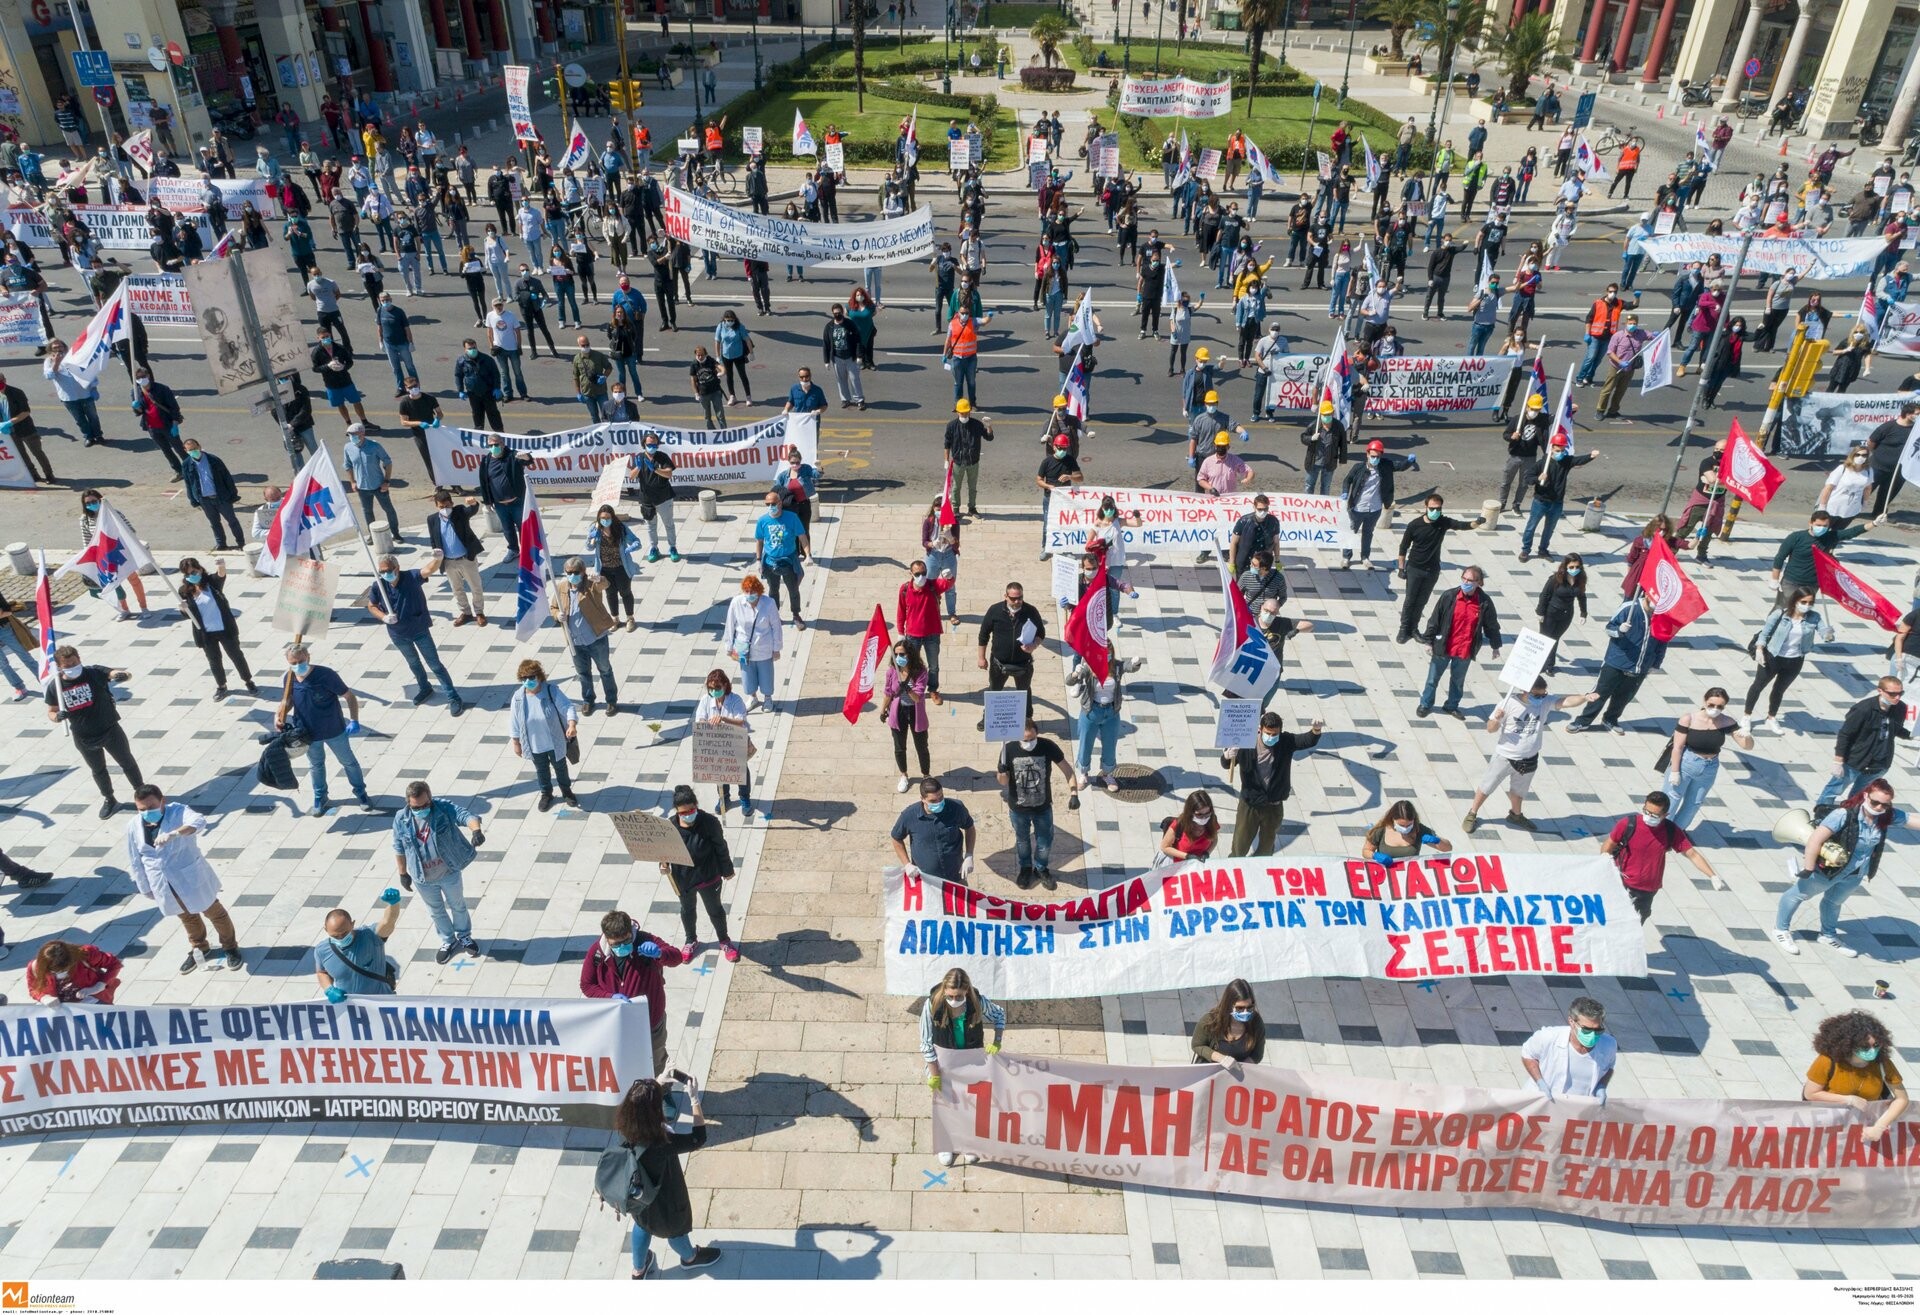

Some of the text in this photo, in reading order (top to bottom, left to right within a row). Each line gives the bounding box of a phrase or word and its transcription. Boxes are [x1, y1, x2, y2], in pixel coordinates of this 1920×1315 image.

[88, 213, 108, 226] ΣΤΟ
[665, 214, 691, 242] ΜΑΗ
[692, 207, 713, 225] ΔΕΝ
[851, 239, 860, 250] Ο
[119, 228, 134, 240] ΤΗΣ
[1381, 359, 1433, 372] ΔΩΡΕΑΝ
[1459, 358, 1486, 372] ΛΑΟ
[1407, 372, 1473, 384] ΔΙΚΑΙΩΜΑΤΑ
[1282, 381, 1501, 398] ΟΧΙ ΣΥΜΒΑΣΕΙΣ ΕΡΓΑΣΙΑΣ
[1365, 398, 1477, 411] ΑΖΟΜΕΝΩΝ ΦΑΡΜΑΚΟΥ
[567, 433, 604, 449] τους
[688, 431, 708, 445] τη
[756, 421, 785, 442] μας
[550, 476, 600, 485] ΒΙΟΜΗΧΑΝΙΚ
[697, 472, 747, 483] ΜΑΚΕΔΟΝΙΑΣ
[1059, 509, 1079, 526] ΝΑ
[1177, 509, 1217, 523] ΤΩΡΑ
[1143, 529, 1217, 544] ΜΕΤΑΛΛΟΥ
[904, 855, 1508, 922] Η ΠΡΩΤΟΜΑΓΙΑ ΕΙΝΑΙ ΤΩΝ ΕΡΓΑΤΩΝ
[899, 919, 1056, 957] ΑΠΑΝΤΗΣΗ
[1079, 915, 1150, 950] ΣΤΗΝ
[1316, 900, 1366, 927] ΤΩΝ
[1380, 894, 1606, 933] ΚΑΠΙΤΑΛΙΣΤΩΝ
[168, 1008, 213, 1046] ΔΕ
[221, 1004, 341, 1042] ΦΕΥΓΕΙ
[347, 1005, 373, 1041] Η
[378, 1006, 561, 1047] ΠΑΝΔΗΜΙΑ
[29, 1051, 206, 1099] ΚΛΑΔΙΚΕΣ
[213, 1048, 270, 1087] ΜΕ
[280, 1047, 432, 1085] ΑΥΞΗΣΕΙΣ
[438, 1049, 523, 1089] ΣΤΗΝ
[529, 1052, 621, 1094] ΥΓΕΙΑ
[1, 1107, 123, 1134] ΠΡΟΣΩΠΙΚΟΥ
[127, 1103, 221, 1125] ΙΔΙΩΤΙΚΩΝ
[325, 1099, 403, 1118] ΙΑΤΡΕΙΩΝ
[407, 1101, 479, 1121] ΒΟΡΕΙΟΥ
[484, 1103, 563, 1123] ΕΛΛΑΔΟΣ
[967, 1081, 1195, 1158] 1η ΜΑΗ
[1224, 1085, 1380, 1145] ΟΡΑΤΟΣ
[1391, 1108, 1552, 1153] ΕΧΘΡΟΣ
[1560, 1118, 1677, 1162] ΕΙΝΑΙ
[1686, 1126, 1717, 1165] Ο
[1219, 1133, 1271, 1177] ΔΕ
[1282, 1144, 1334, 1185] ΘΑ
[1348, 1151, 1549, 1194] ΠΛΗΡΩΣΕΙ
[1557, 1162, 1671, 1207] ΞΑΝΑ
[1685, 1171, 1715, 1209] Ο
[1723, 1175, 1841, 1214] ΛΑΟΣ
